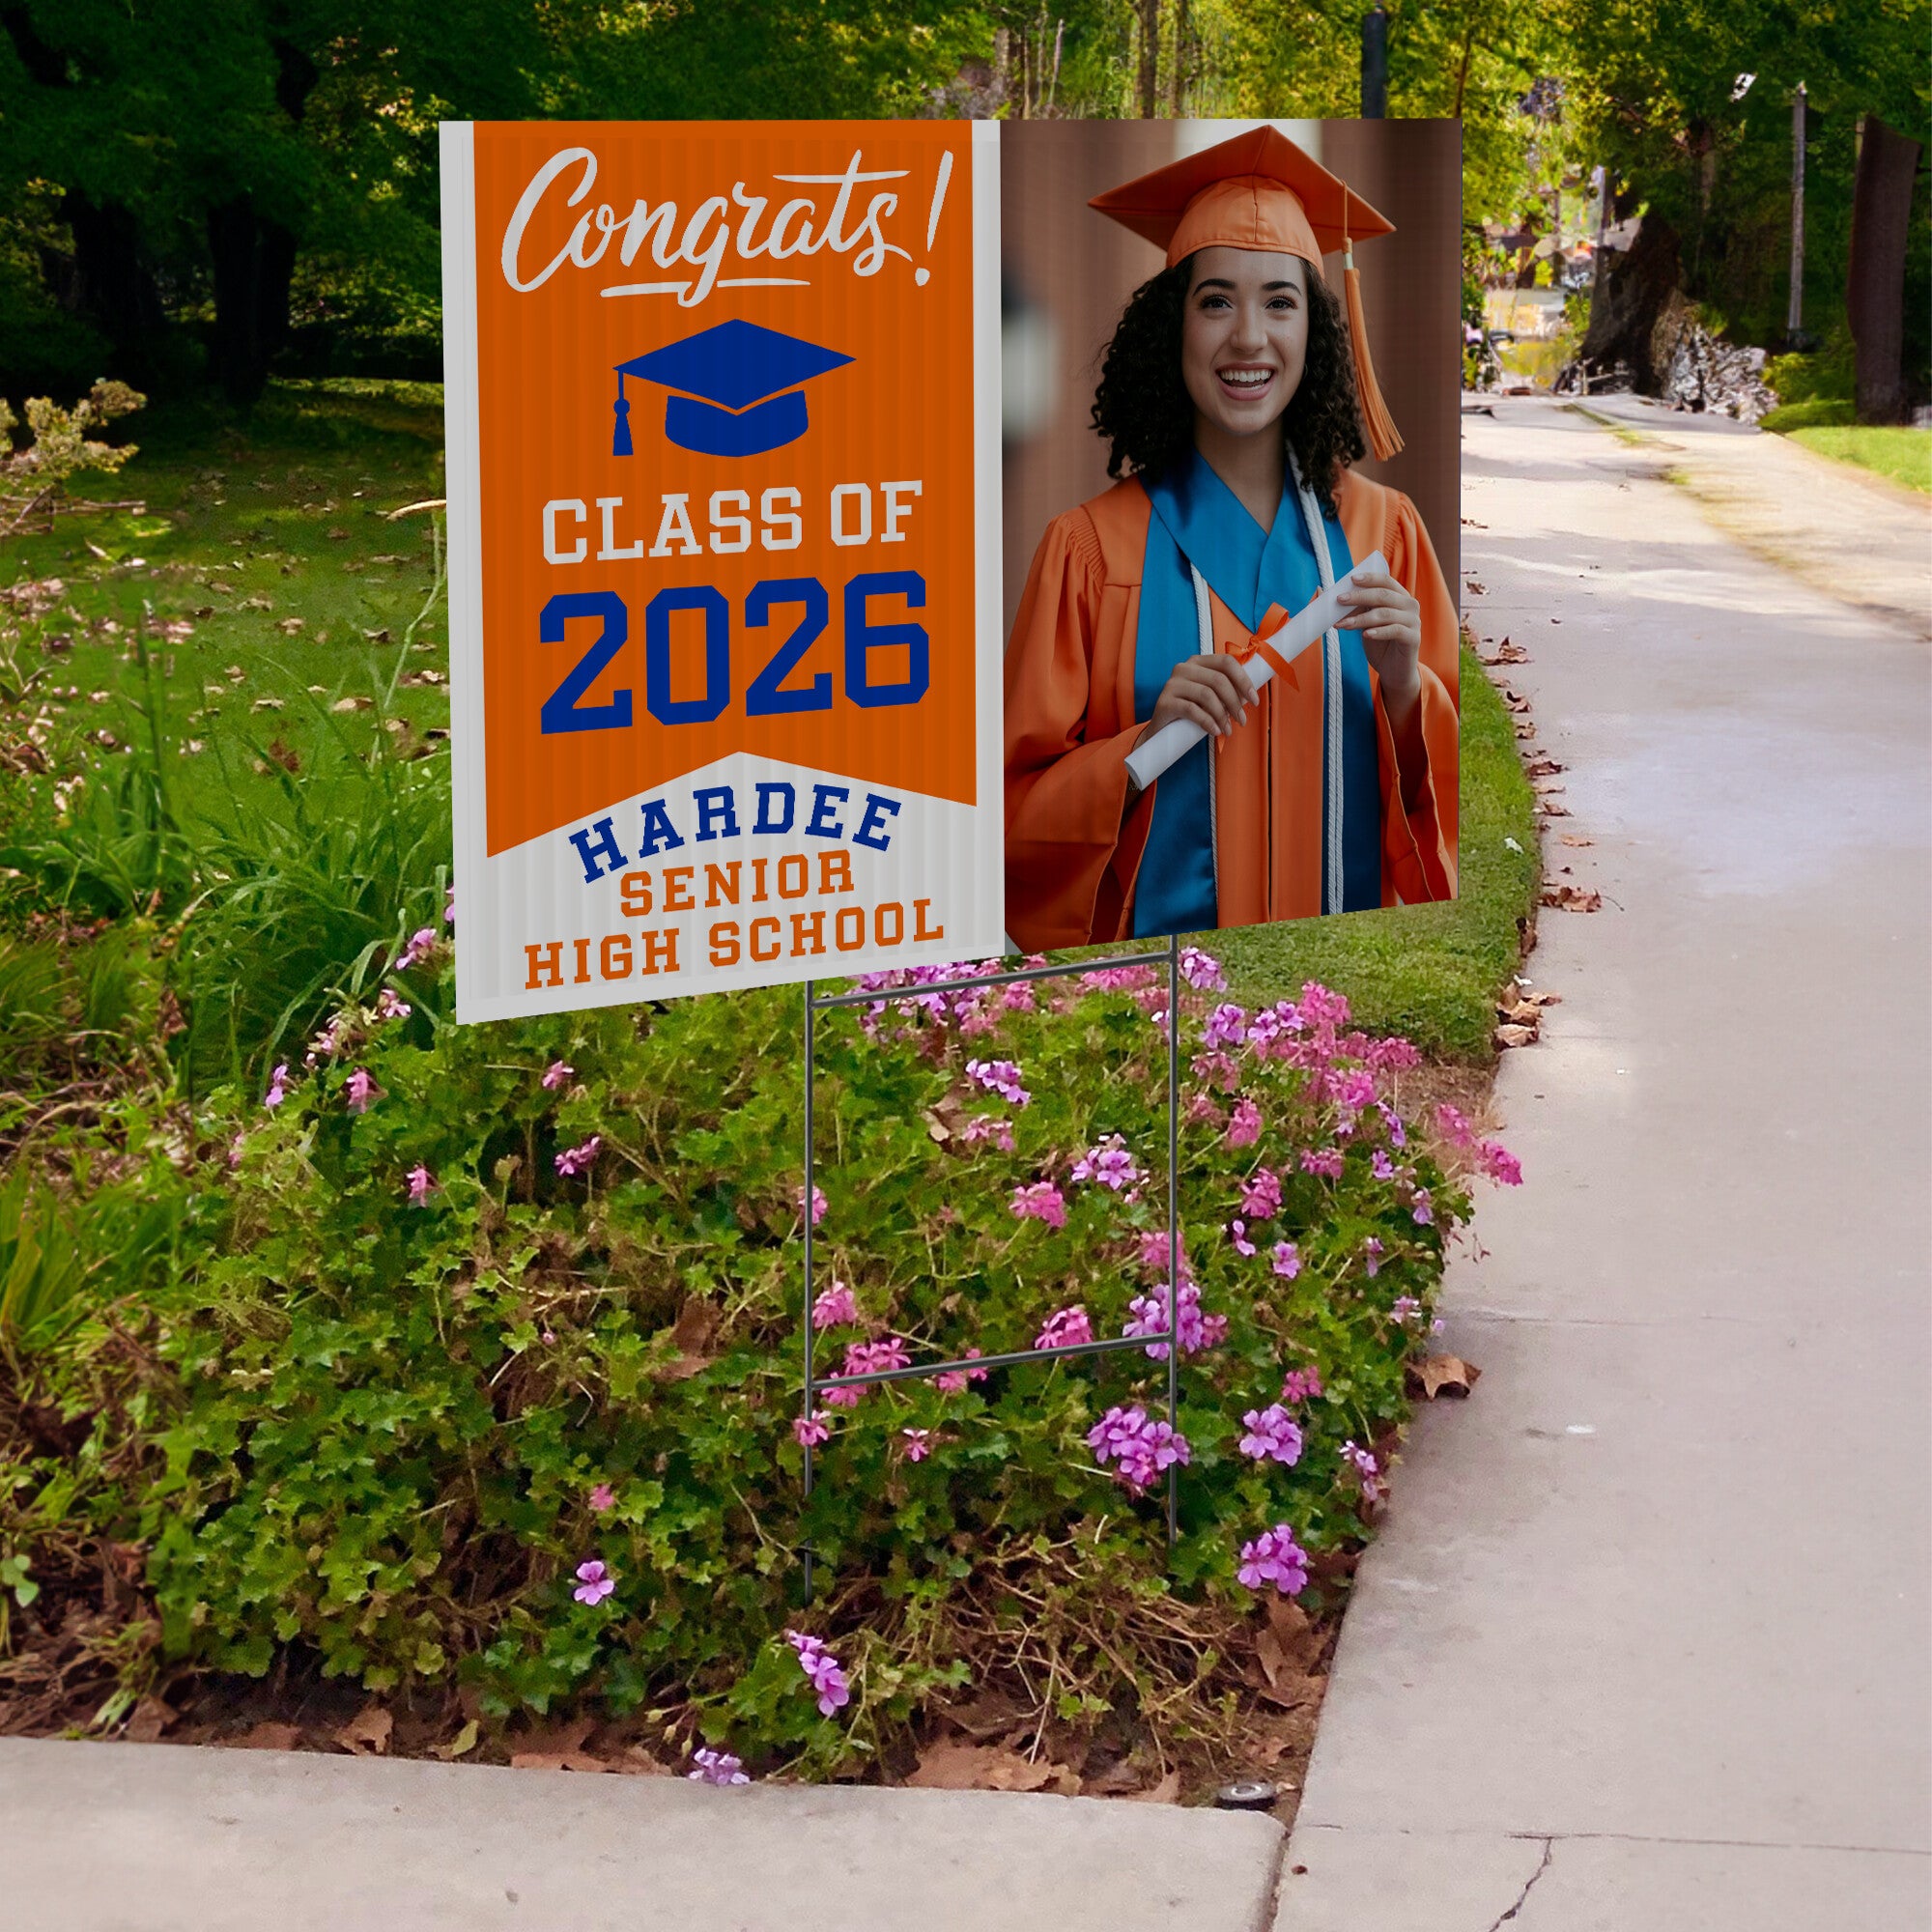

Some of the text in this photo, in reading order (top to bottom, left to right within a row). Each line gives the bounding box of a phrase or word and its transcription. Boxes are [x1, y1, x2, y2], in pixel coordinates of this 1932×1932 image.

[501, 147, 953, 307] Congrats!
[543, 480, 922, 564] CLASS OF
[540, 570, 929, 734] 2026
[569, 782, 901, 883] HARDEE
[620, 850, 854, 917] SENIOR
[525, 899, 944, 989] HIGH SCHOOL
